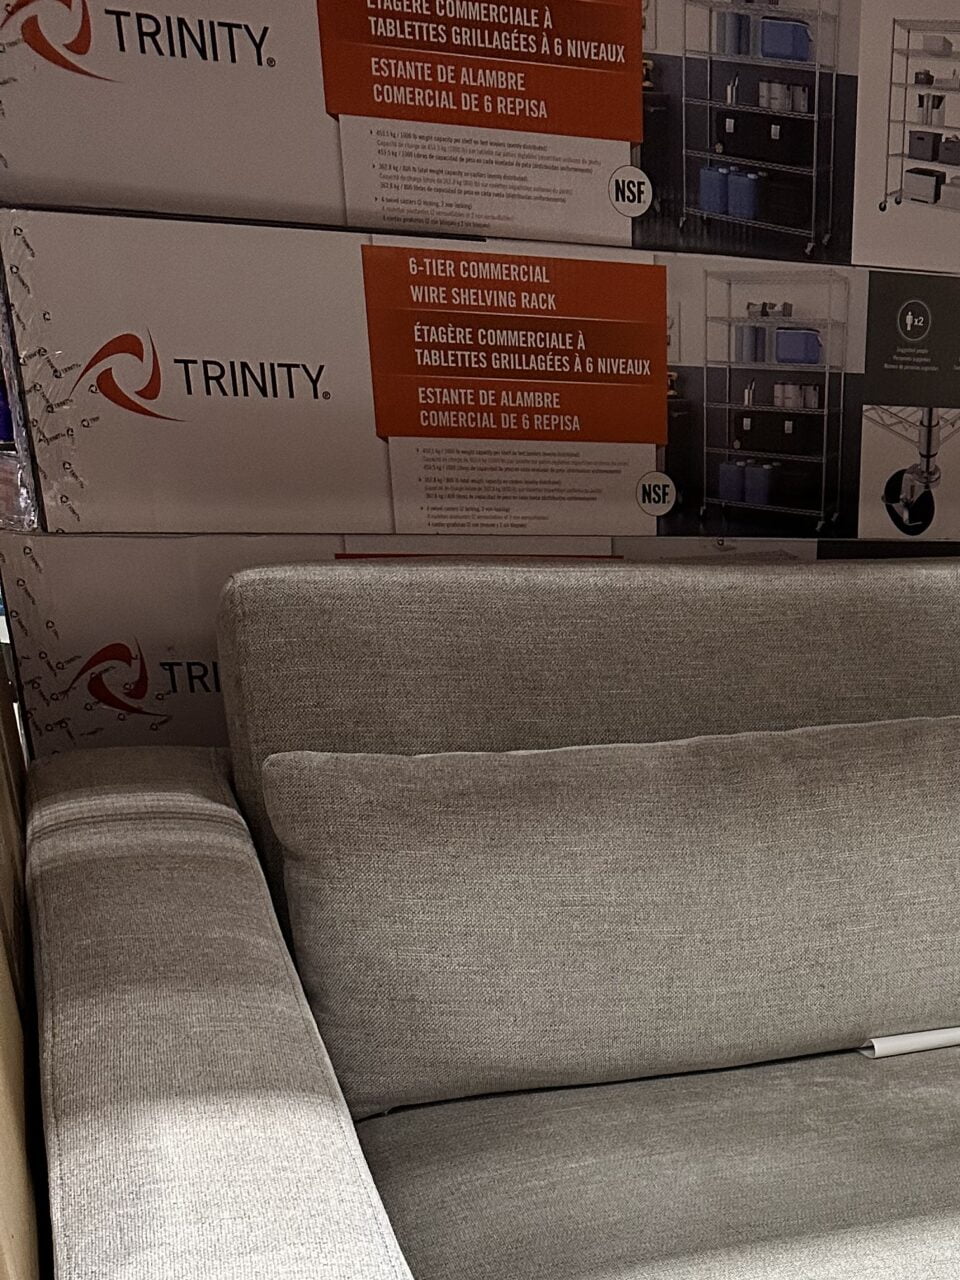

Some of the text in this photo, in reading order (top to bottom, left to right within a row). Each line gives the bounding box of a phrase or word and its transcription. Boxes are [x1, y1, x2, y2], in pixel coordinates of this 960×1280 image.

[436, 0, 539, 28] COMMERCIALE
[543, 6, 553, 29] À
[368, 16, 626, 63] TABLETTES GRILLAGÉES À 6 NIVEAUX
[371, 57, 526, 91] ESTANTE DE ALAMBRE
[373, 83, 548, 119] COMERCIAL DE 6 REPISA
[614, 179, 644, 204] NSF
[409, 257, 551, 284] 6-TIER COMMERCIAL
[410, 284, 557, 311] WIRE SHELVING RACK
[414, 322, 586, 350] ÉTAGÈRE COMMERCIALE À
[415, 348, 651, 376] TABLETTES GRILLAGÉES À 6 NIVEAUX
[418, 387, 561, 409] ESTANTE DE ALAMBRE
[420, 410, 580, 431] COMERCIAL DE 6 REPISA
[642, 484, 670, 504] NSF
